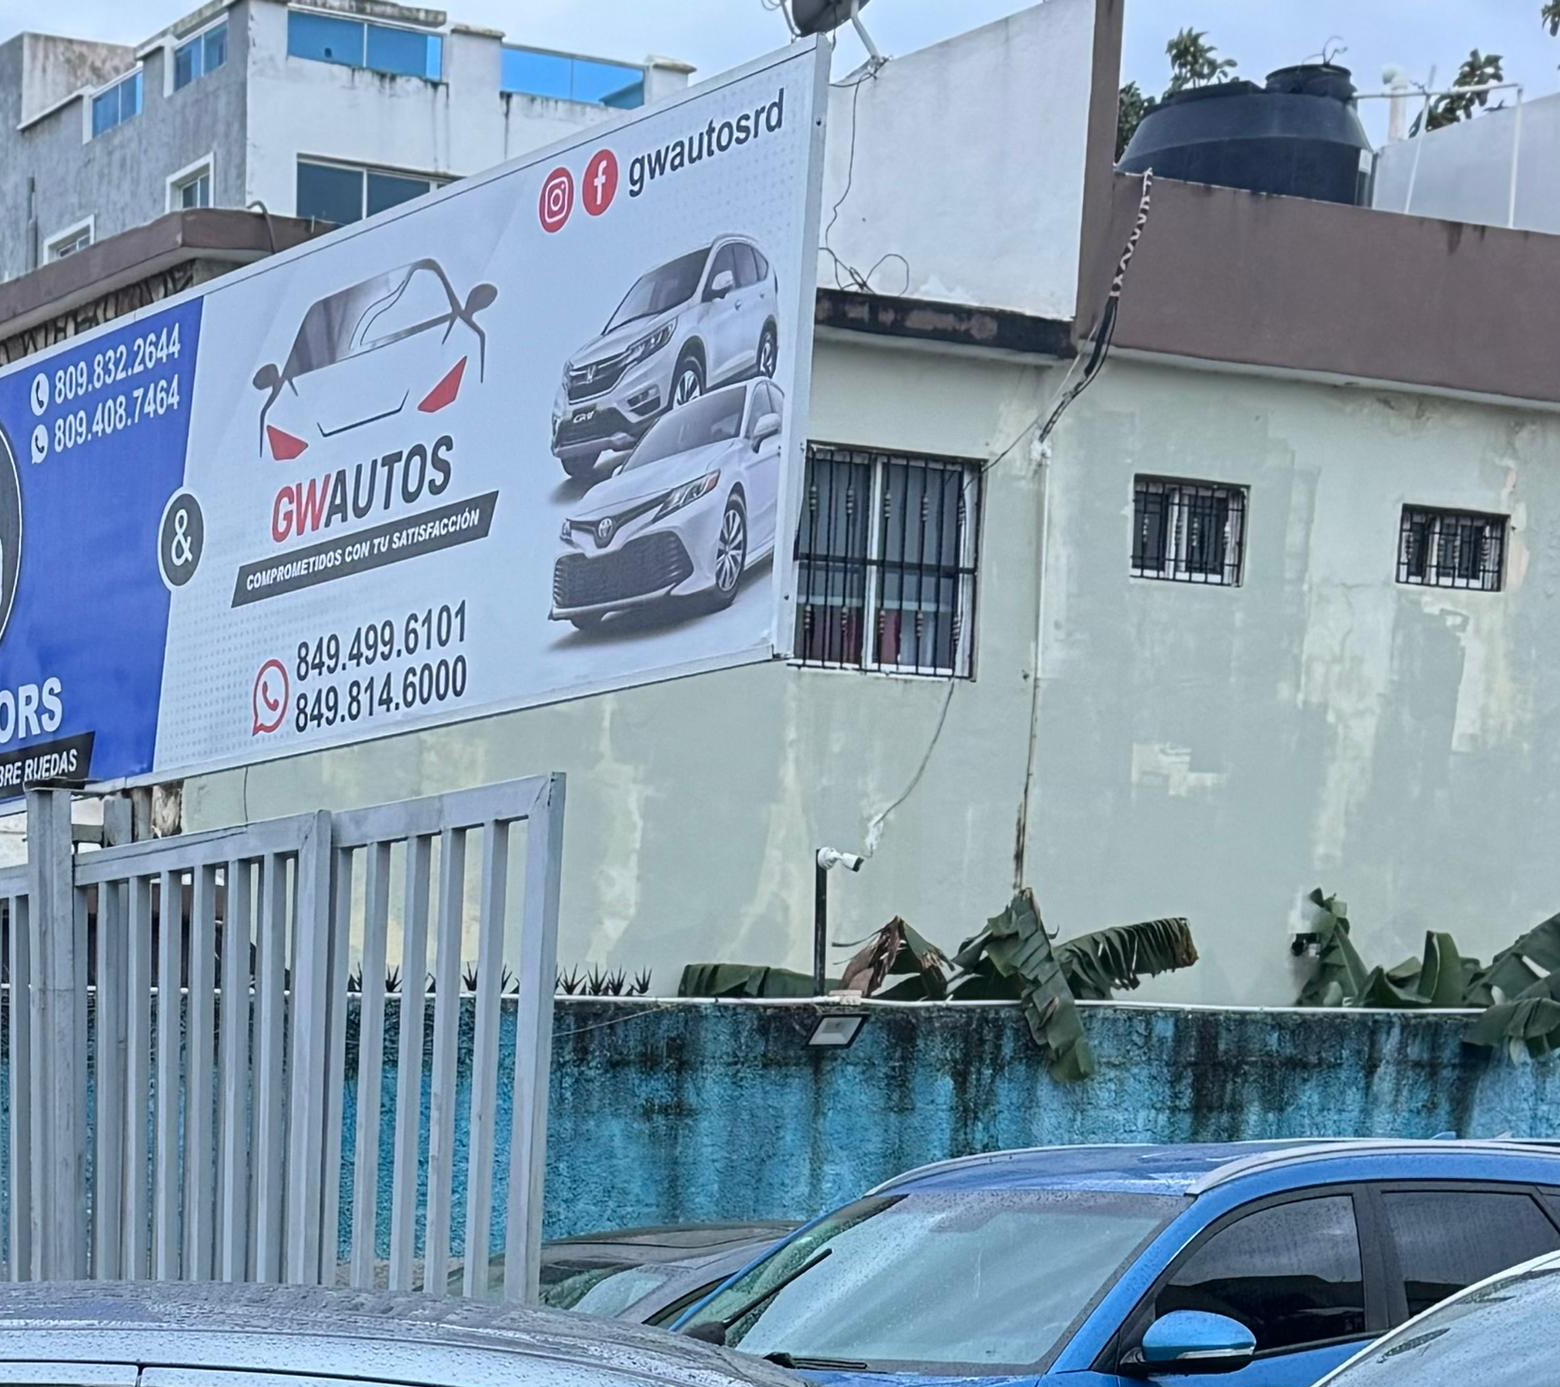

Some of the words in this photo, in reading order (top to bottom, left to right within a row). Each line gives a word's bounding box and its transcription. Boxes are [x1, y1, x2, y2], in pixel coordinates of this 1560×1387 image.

[628, 87, 785, 198] gwautosrd
[54, 322, 181, 405] 809.832.2644
[54, 373, 180, 453] 809.408.7464
[271, 434, 454, 543] GWAUTOS
[171, 508, 193, 566] &
[246, 548, 342, 591] COMPROMETIDOS
[344, 543, 370, 563] CON
[372, 534, 390, 555] TU
[392, 506, 480, 549] SATISFACCIÓN
[296, 599, 467, 682] 849.499.6101
[295, 654, 467, 733] 849.814.6000
[24, 748, 78, 781] RUEDAS
